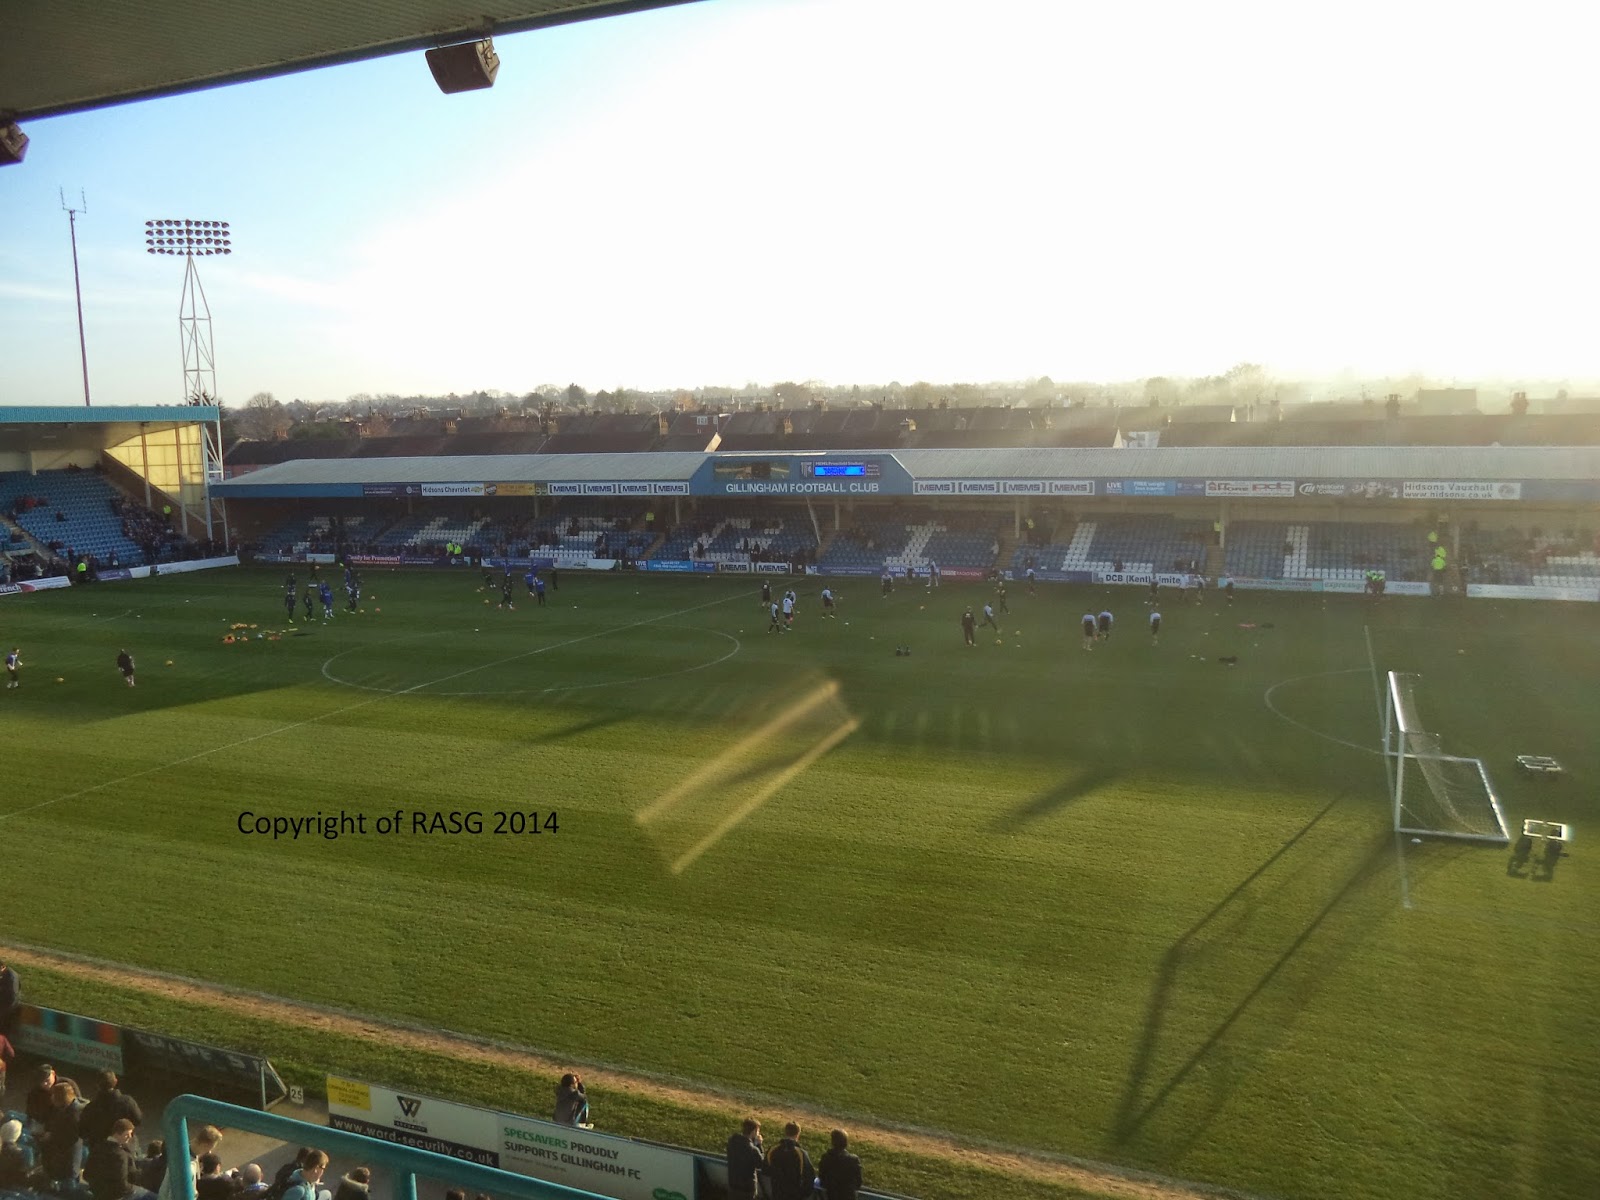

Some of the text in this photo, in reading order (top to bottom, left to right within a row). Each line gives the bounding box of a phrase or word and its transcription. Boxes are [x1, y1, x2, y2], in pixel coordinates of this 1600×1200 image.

[423, 485, 471, 494] Hidsons Chevrolet
[726, 483, 880, 494] GILLINGHAM FOOTBALL CLUB
[1404, 483, 1493, 492] Hidsons Vauxhall
[1105, 574, 1123, 583] DCB
[291, 1089, 304, 1100] 25
[334, 1118, 495, 1166] www.ward-security.co.uk
[504, 1127, 619, 1160] SPECSAVERS PROUDLY
[505, 1141, 559, 1161] SUPPORTS
[560, 1153, 625, 1178] GILLINGHAM
[627, 1168, 641, 1181] FC
